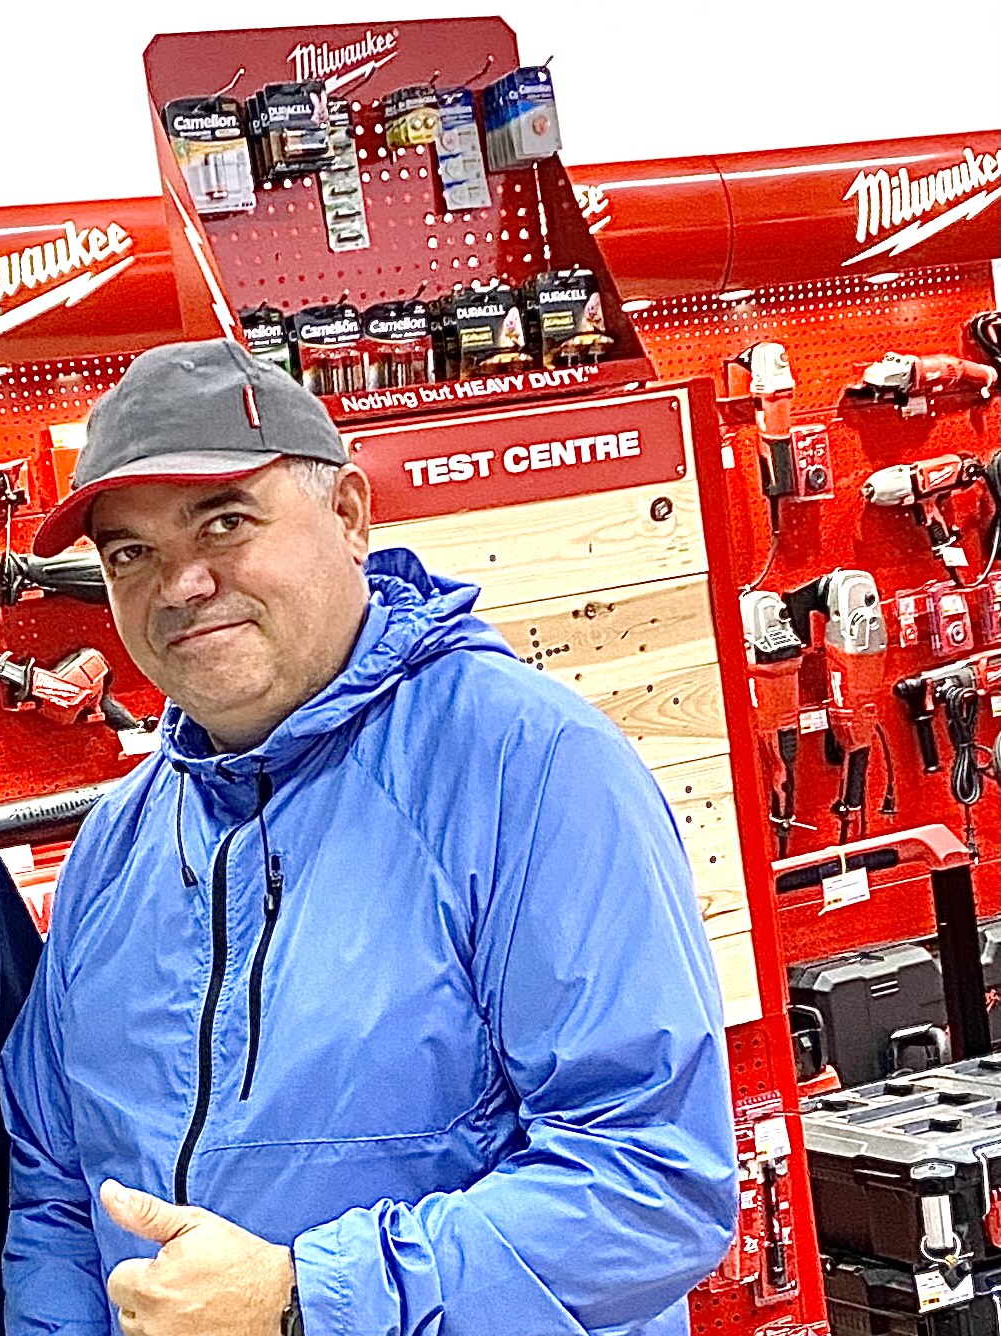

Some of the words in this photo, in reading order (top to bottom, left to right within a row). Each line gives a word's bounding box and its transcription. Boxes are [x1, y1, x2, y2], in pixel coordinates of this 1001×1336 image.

[287, 28, 398, 83] Milwaukee
[173, 114, 238, 131] Camelion
[843, 148, 1001, 243] Milwauke
[457, 304, 505, 319] DURACELL
[301, 319, 359, 339] Camelion
[369, 317, 426, 335] Camelion
[341, 390, 419, 412] Nothing
[419, 385, 454, 402] but
[454, 375, 524, 398] HEAVY
[404, 451, 495, 487] TEST
[503, 431, 641, 473] CENTRE
